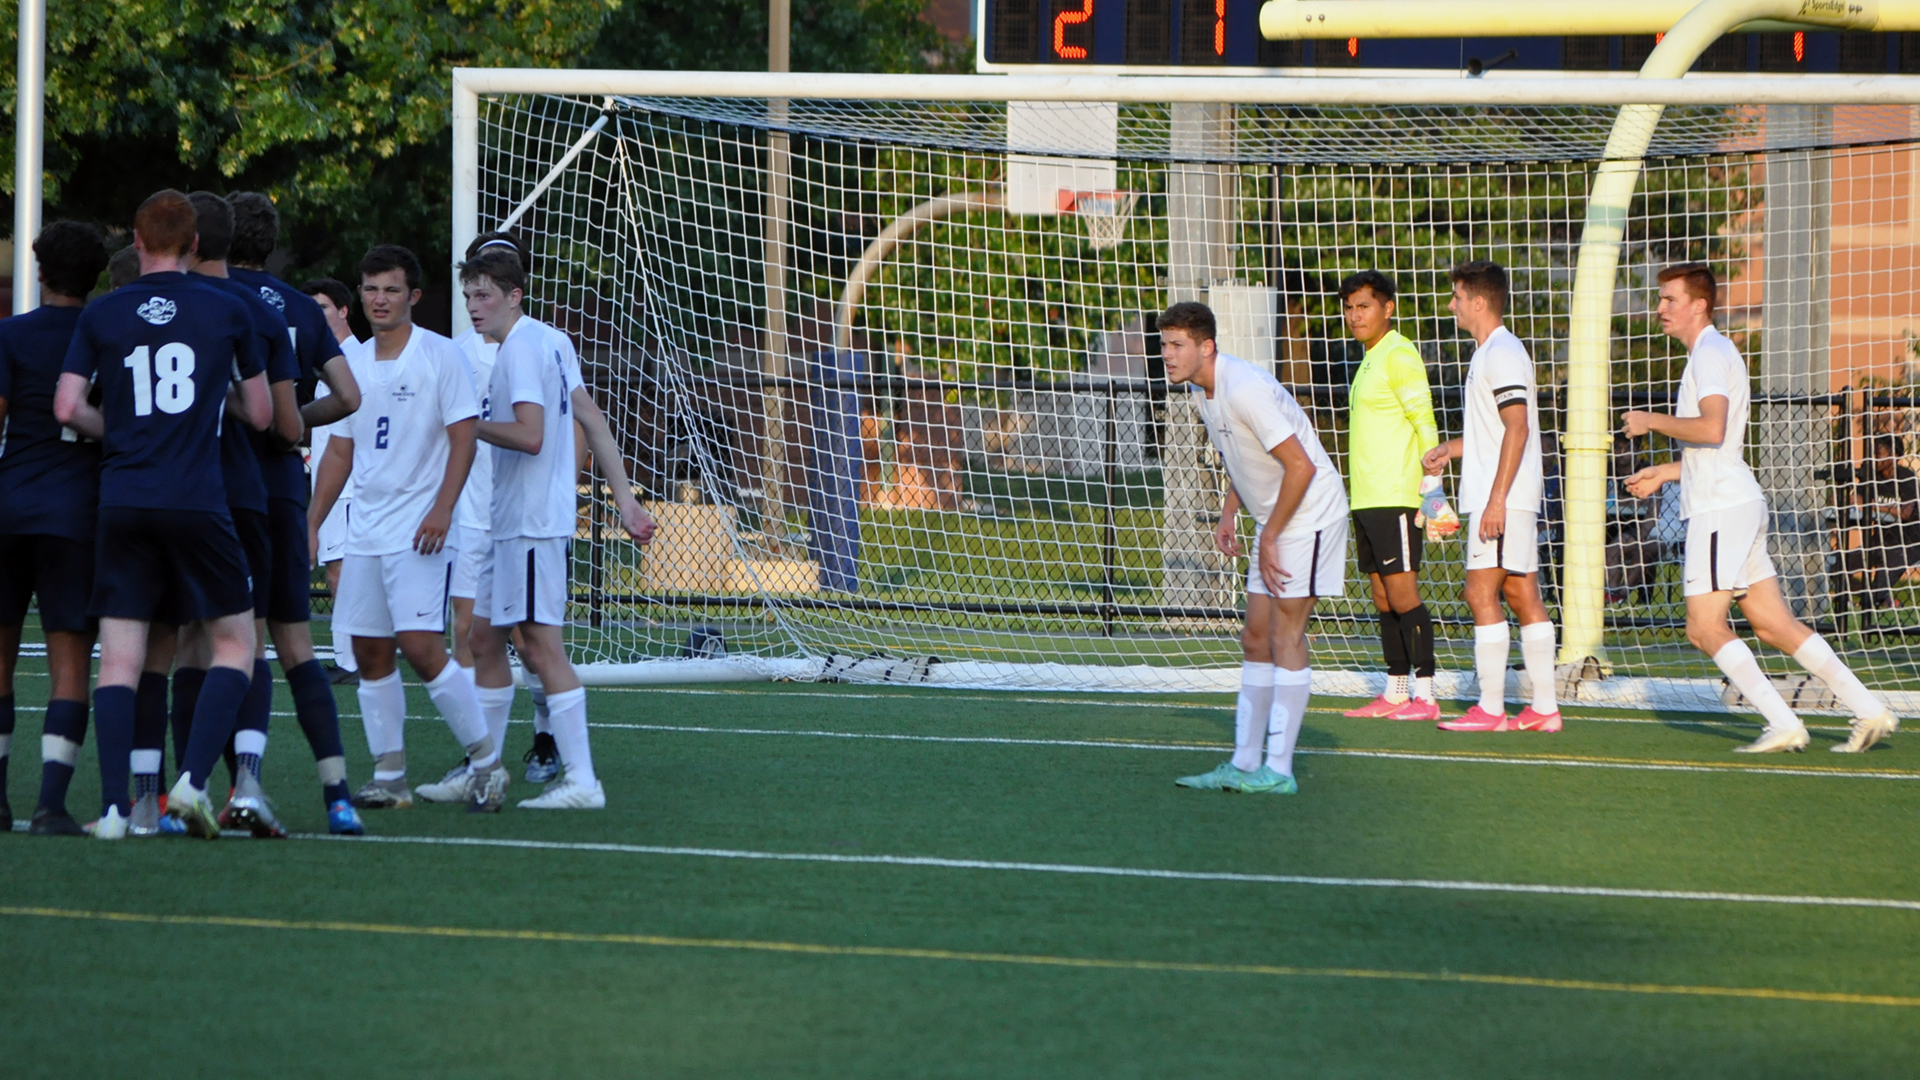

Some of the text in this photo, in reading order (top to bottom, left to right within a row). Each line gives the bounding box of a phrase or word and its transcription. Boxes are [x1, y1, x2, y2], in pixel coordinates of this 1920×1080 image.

[1054, 0, 1093, 59] 2
[123, 341, 196, 417] 18
[375, 415, 390, 450] 2
